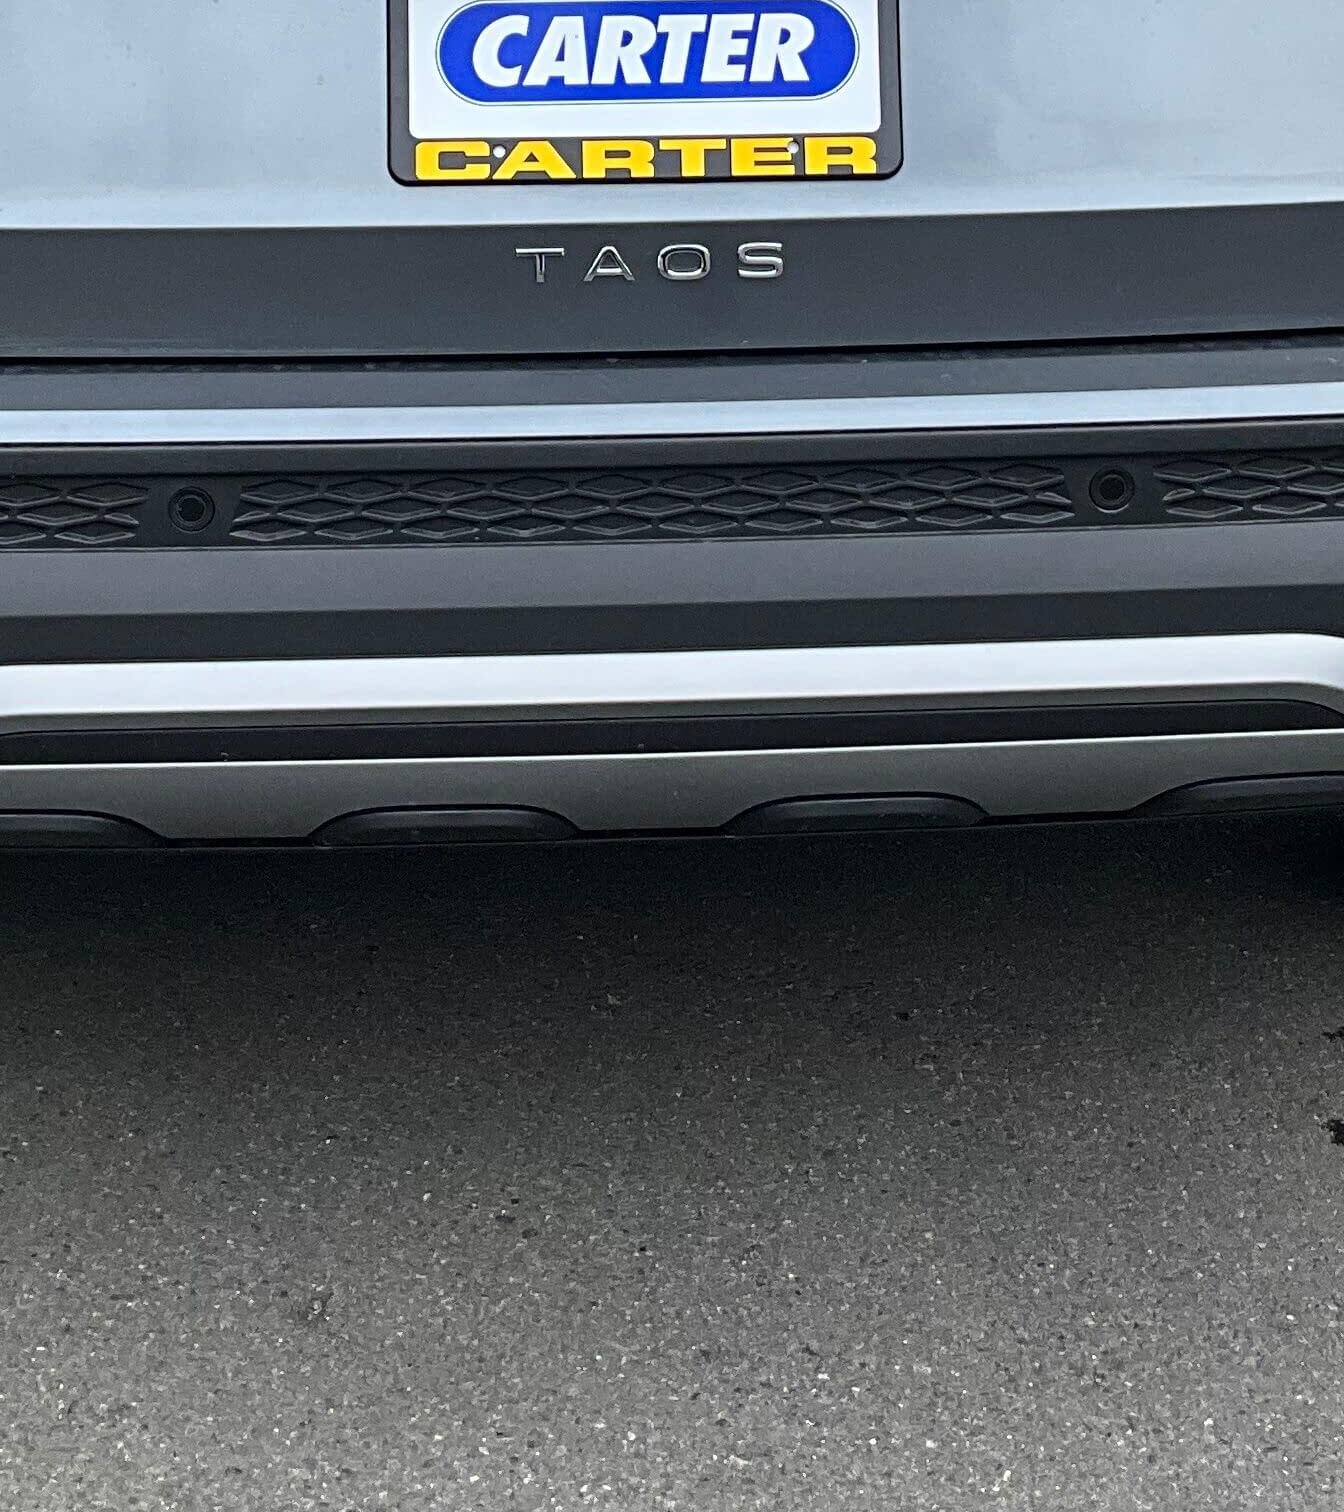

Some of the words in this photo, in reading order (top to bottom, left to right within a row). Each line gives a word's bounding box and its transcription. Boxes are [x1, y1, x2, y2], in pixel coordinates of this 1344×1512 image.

[471, 12, 816, 88] CARTER
[414, 136, 878, 181] CARTER
[514, 241, 787, 283] TAOS
